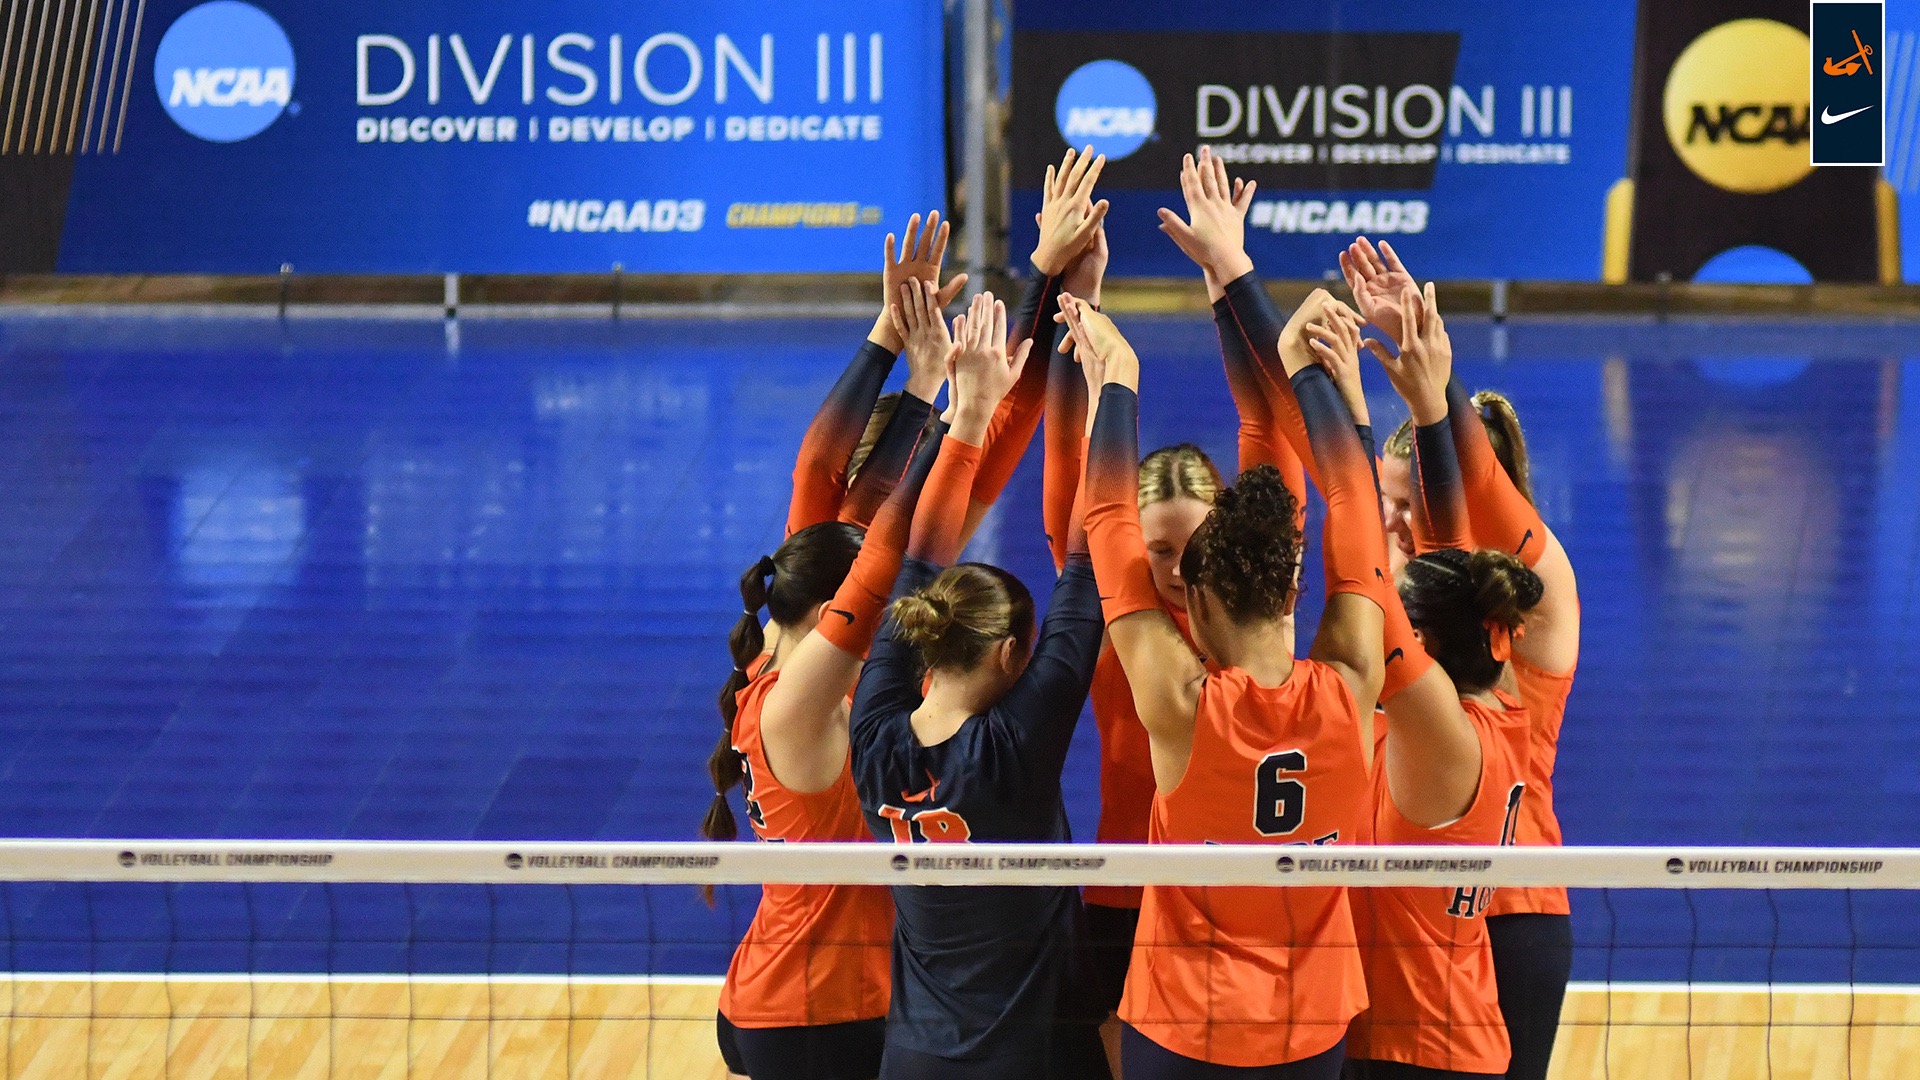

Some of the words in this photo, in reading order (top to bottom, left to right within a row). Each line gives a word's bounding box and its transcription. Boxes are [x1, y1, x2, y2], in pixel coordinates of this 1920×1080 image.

[356, 33, 774, 106] DIVISION
[816, 32, 883, 104] III
[169, 68, 289, 107] NCAA
[1065, 107, 1155, 137] NCAA
[1196, 84, 1495, 138] DIVISION
[1521, 84, 1572, 138] III
[1686, 104, 1810, 144] NCA
[356, 116, 517, 143] DISCOVER
[548, 116, 695, 143] DEVELOP
[724, 115, 882, 142] DEDICATE
[1331, 143, 1438, 164] DEVELOP
[1456, 143, 1571, 164] DEDICATE
[527, 199, 705, 232] #NCAAD3
[1251, 200, 1429, 234] #NCAAD3
[1253, 749, 1307, 837] 6
[141, 854, 220, 866] VOLLEYBALL
[226, 854, 334, 867] CHAMPIONSHIP
[527, 856, 608, 869] VOLLEYBALL
[612, 856, 720, 869] CHAMPIONSHIP
[913, 857, 993, 870] VOLLEYBALL
[999, 857, 1106, 870] CHAMPIONSHIP
[1299, 859, 1379, 872] VOLLEYBALL
[1384, 859, 1492, 872] CHAMPIONSHIP
[1689, 861, 1769, 873] VOLLEYBALL
[1774, 861, 1883, 873] CHAMPIONSHIP
